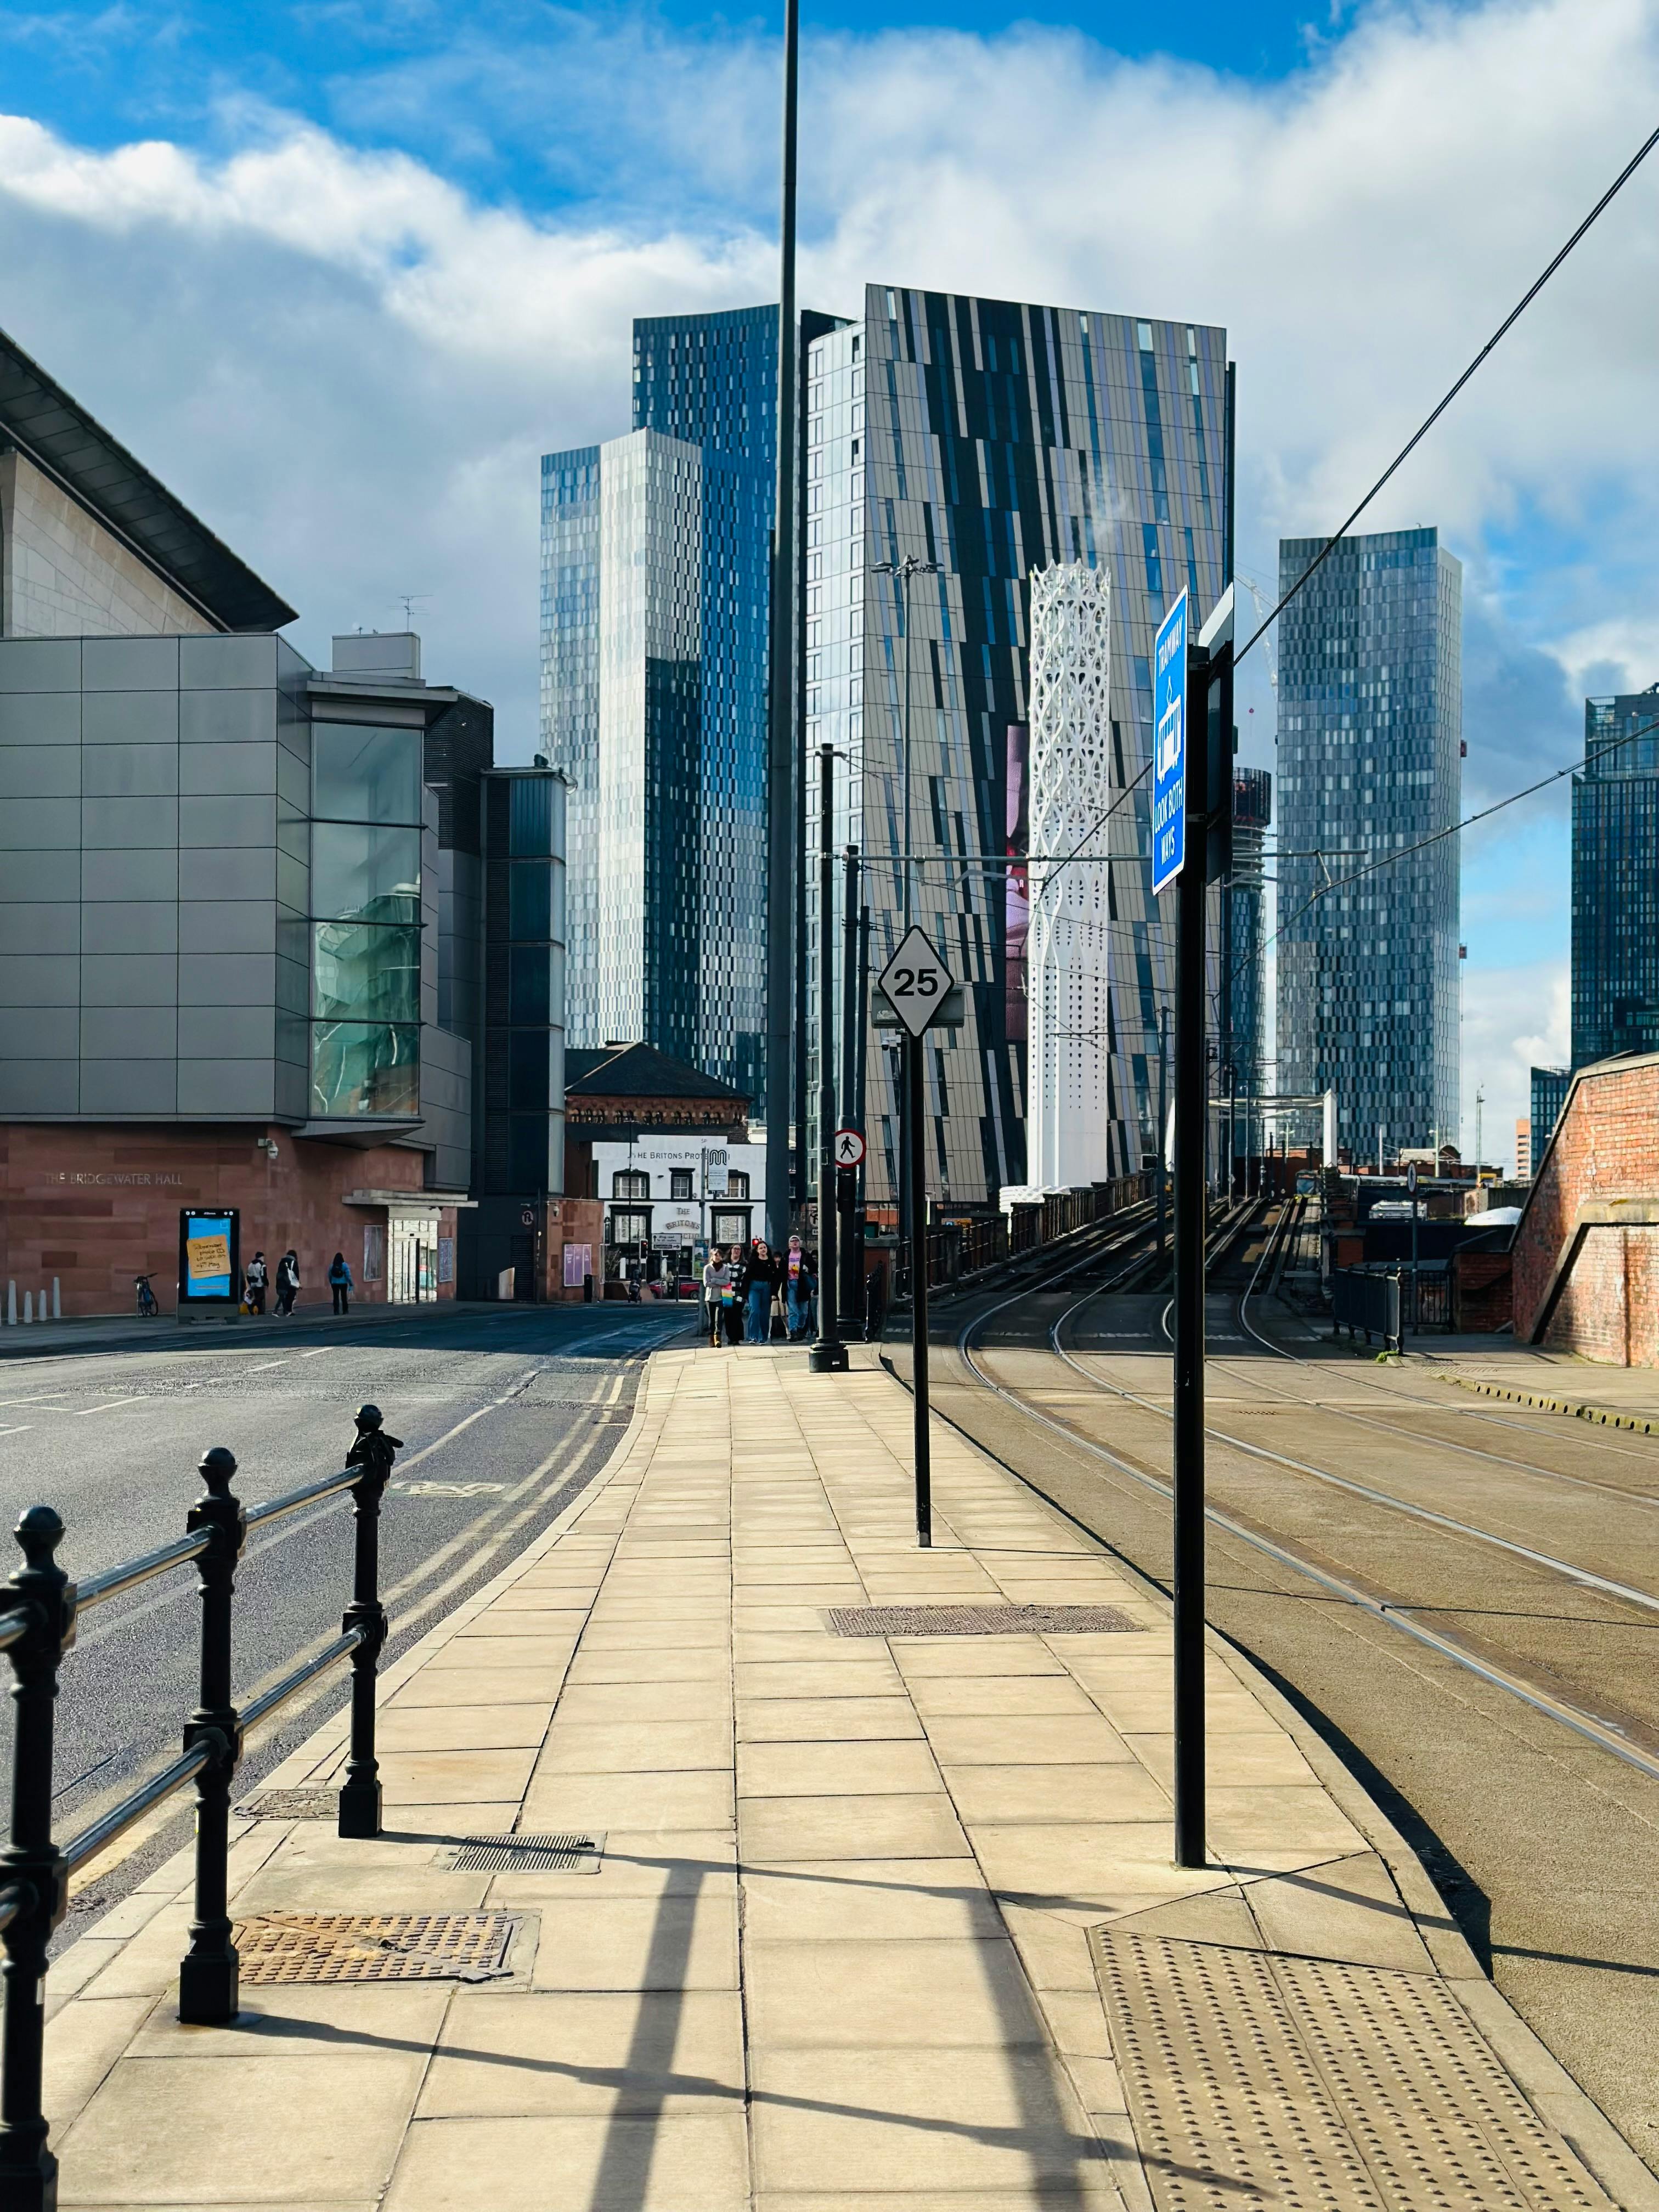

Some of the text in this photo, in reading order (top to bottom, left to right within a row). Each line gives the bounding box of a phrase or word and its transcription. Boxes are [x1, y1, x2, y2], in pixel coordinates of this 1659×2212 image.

[1159, 613, 1183, 677] TRAMWAY
[1155, 776, 1183, 834] LOOK BOTH
[1161, 825, 1175, 865] WAYS
[894, 968, 939, 996] 25
[45, 1173, 183, 1186] THE BRIDGEWATER HALL
[665, 1220, 701, 1229] BRITONS
